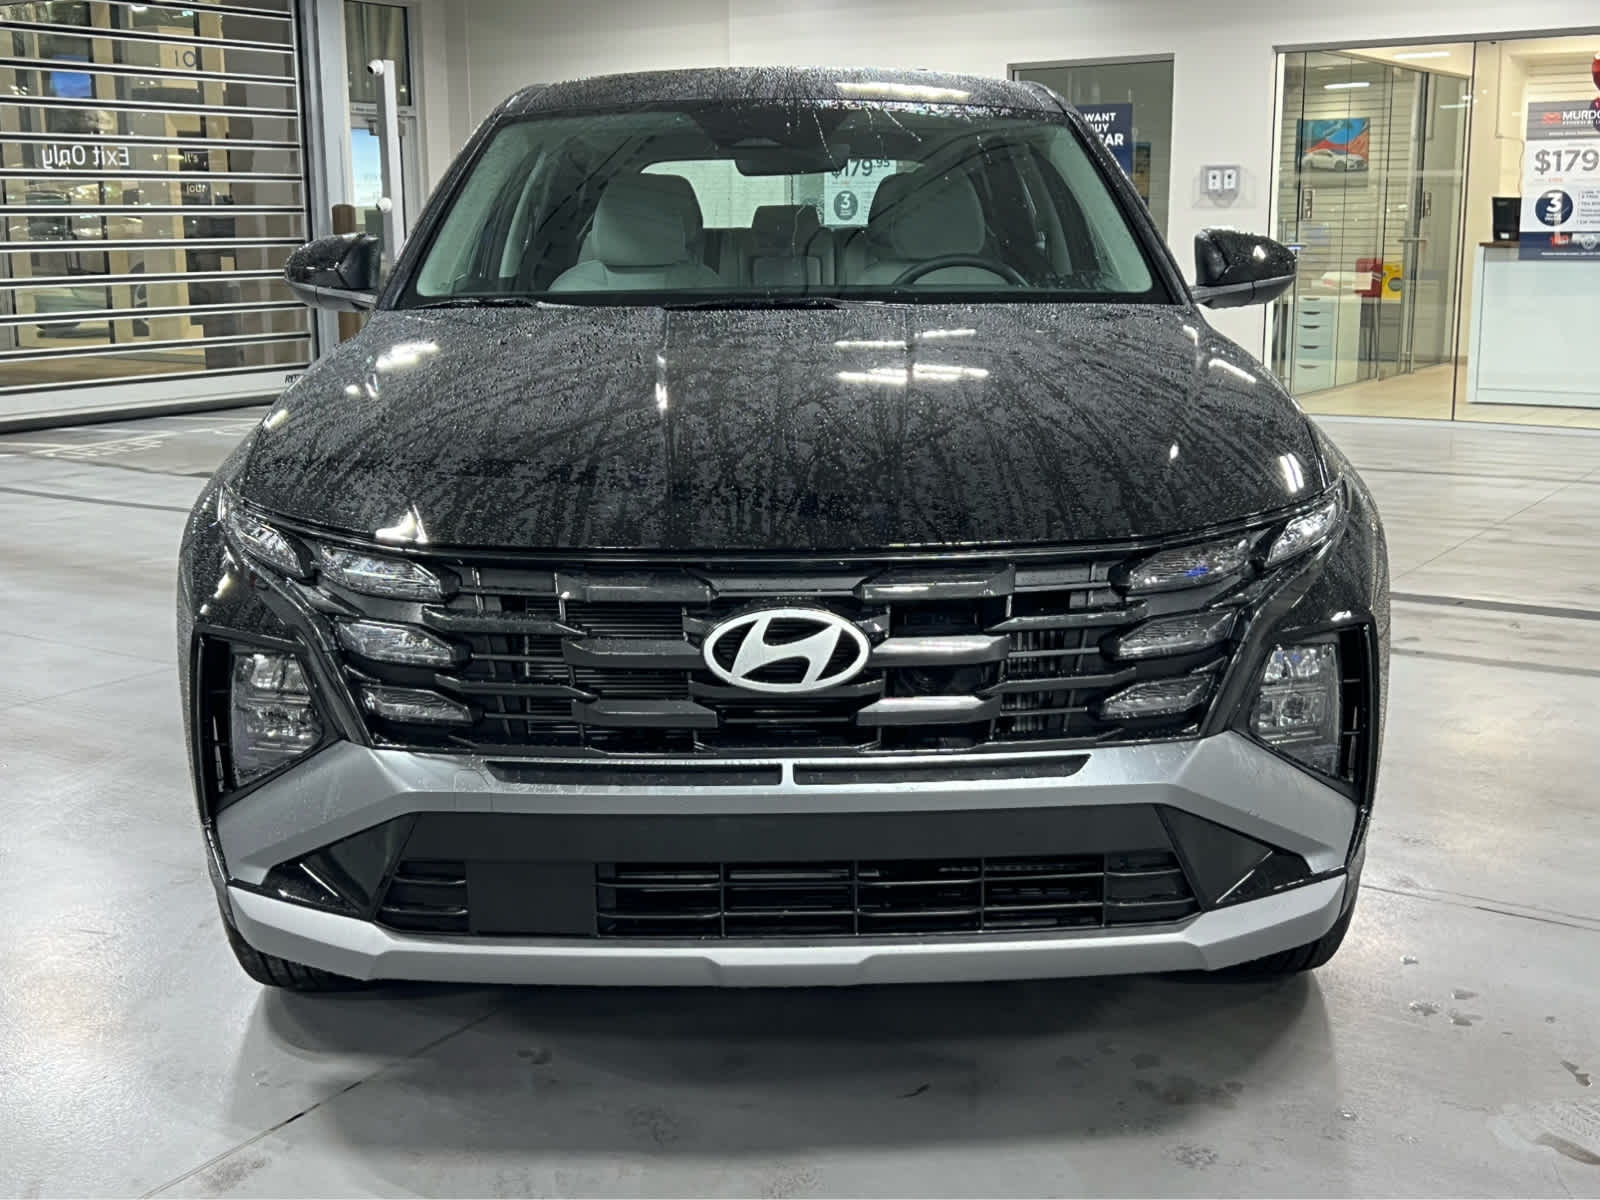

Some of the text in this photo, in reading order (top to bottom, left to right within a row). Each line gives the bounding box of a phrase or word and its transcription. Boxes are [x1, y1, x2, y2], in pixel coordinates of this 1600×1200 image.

[1083, 112, 1117, 122] WANT
[1534, 149, 1599, 175] $179
[840, 193, 851, 209] 3
[1546, 192, 1563, 213] 3
